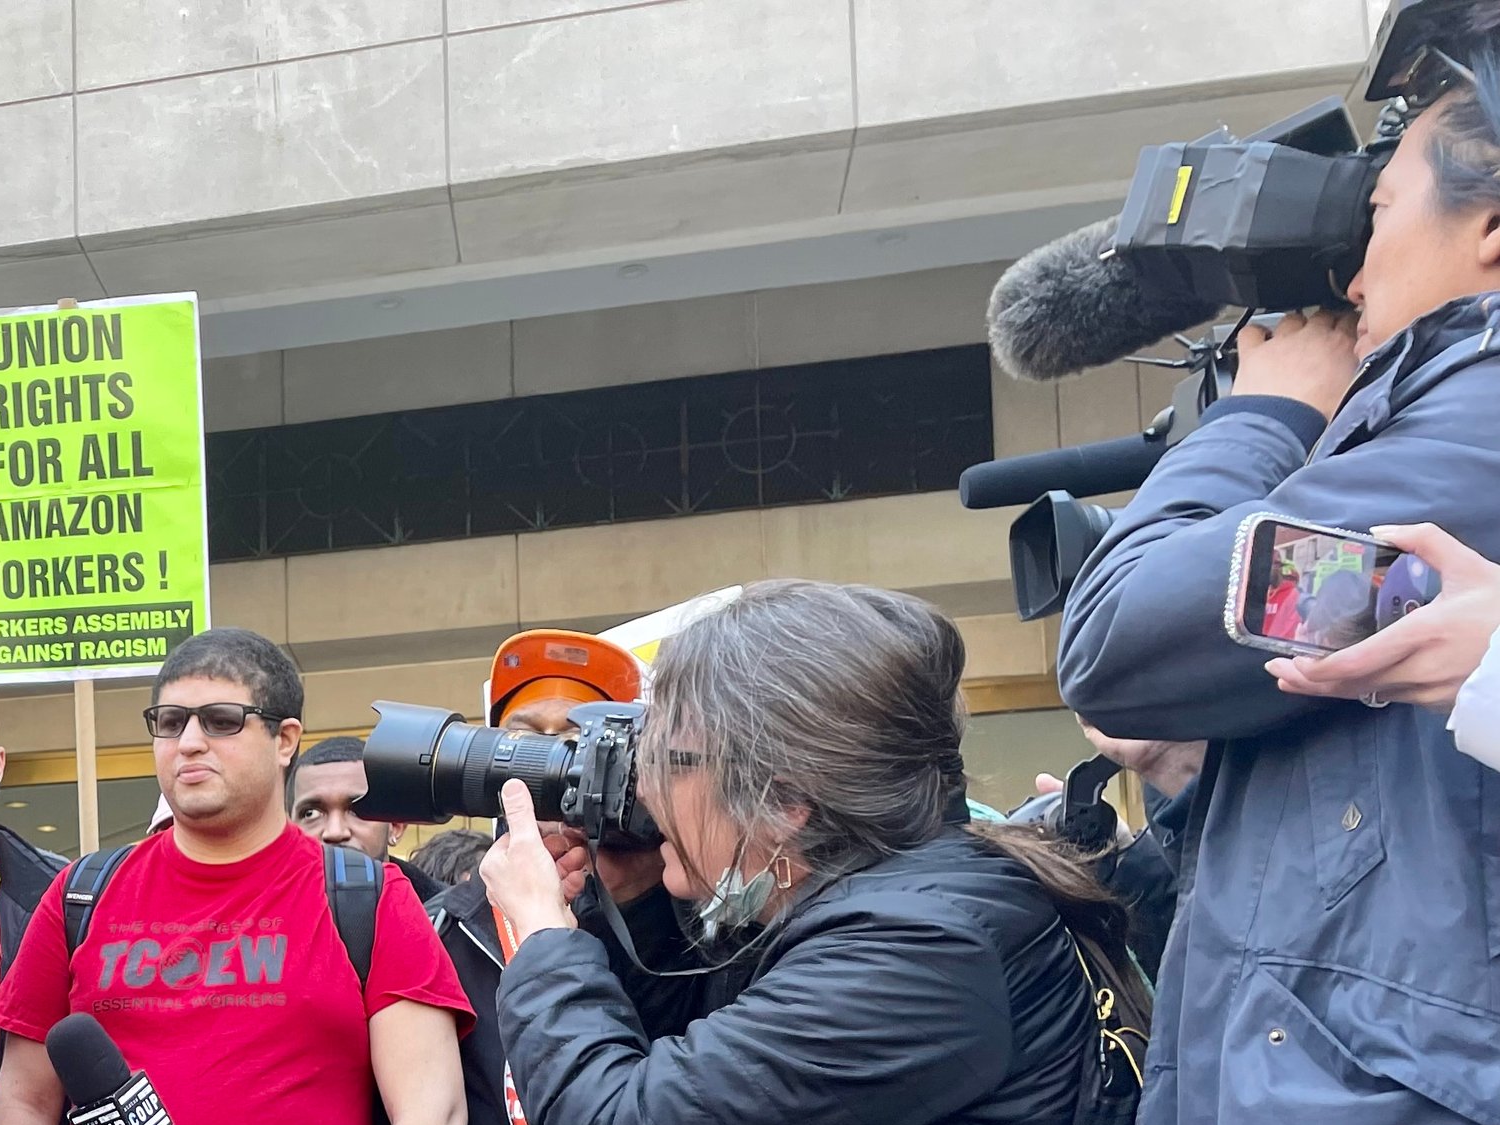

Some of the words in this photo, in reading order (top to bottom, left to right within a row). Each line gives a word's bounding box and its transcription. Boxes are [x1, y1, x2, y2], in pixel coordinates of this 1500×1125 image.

[77, 430, 154, 481] ALL
[158, 550, 169, 590] !
[72, 609, 191, 633] ASSEMBLY
[79, 637, 167, 661] RACISM
[92, 996, 186, 1014] ESSENTIAL
[191, 992, 287, 1009] WORKERS
